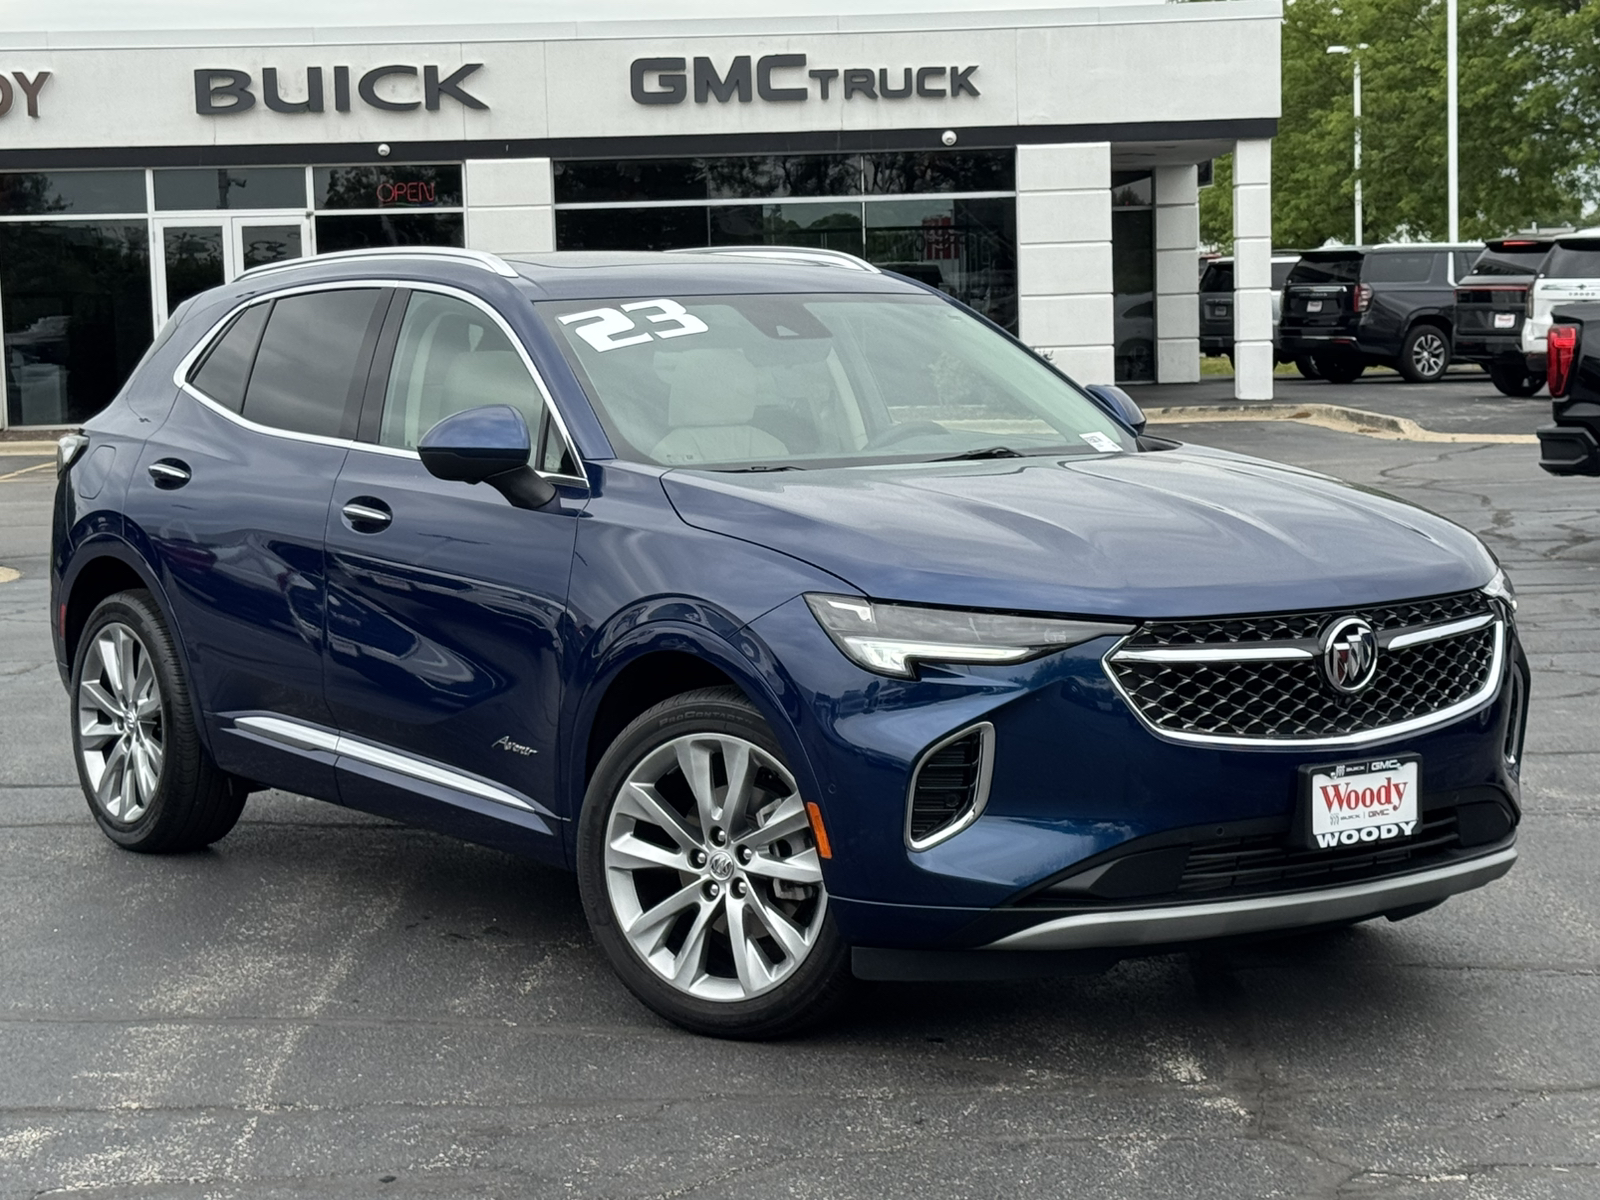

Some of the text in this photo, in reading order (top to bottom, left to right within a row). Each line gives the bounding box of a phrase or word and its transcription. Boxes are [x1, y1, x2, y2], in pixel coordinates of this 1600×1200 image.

[194, 63, 490, 114] BUICK
[630, 53, 981, 105] GMC TRUCK
[376, 182, 435, 202] OPEN
[558, 299, 709, 352] 23
[1346, 759, 1399, 773] BUICK GMC
[1319, 777, 1408, 813] Woody
[1368, 808, 1390, 818] GMC
[1316, 820, 1418, 848] WOODY
